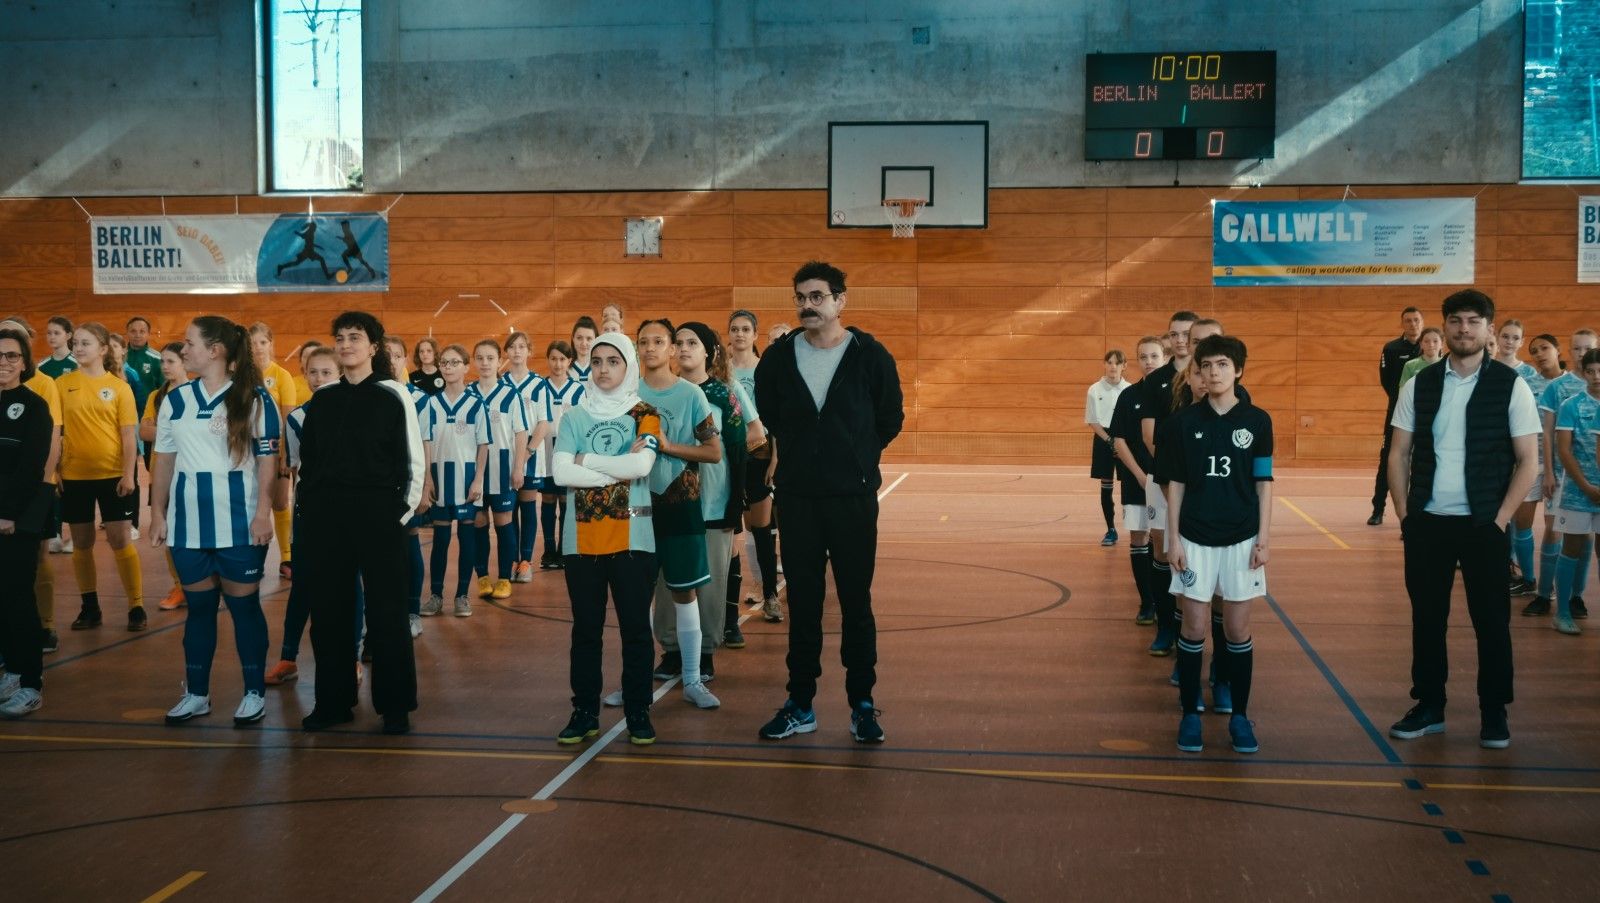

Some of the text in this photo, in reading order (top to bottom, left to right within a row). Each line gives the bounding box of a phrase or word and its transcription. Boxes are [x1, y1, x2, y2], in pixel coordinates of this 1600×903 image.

[1093, 85, 1158, 102] BERLIN
[1190, 83, 1266, 100] BALLERT
[1135, 132, 1152, 157] 0
[1207, 131, 1224, 156] 0
[97, 226, 162, 246] BERLIN
[1221, 212, 1368, 243] CALLWELT
[97, 248, 182, 268] BALLERT!
[1286, 265, 1437, 275] calling worldwide for less money
[610, 421, 630, 433] SCHULE
[1206, 455, 1231, 477] 13
